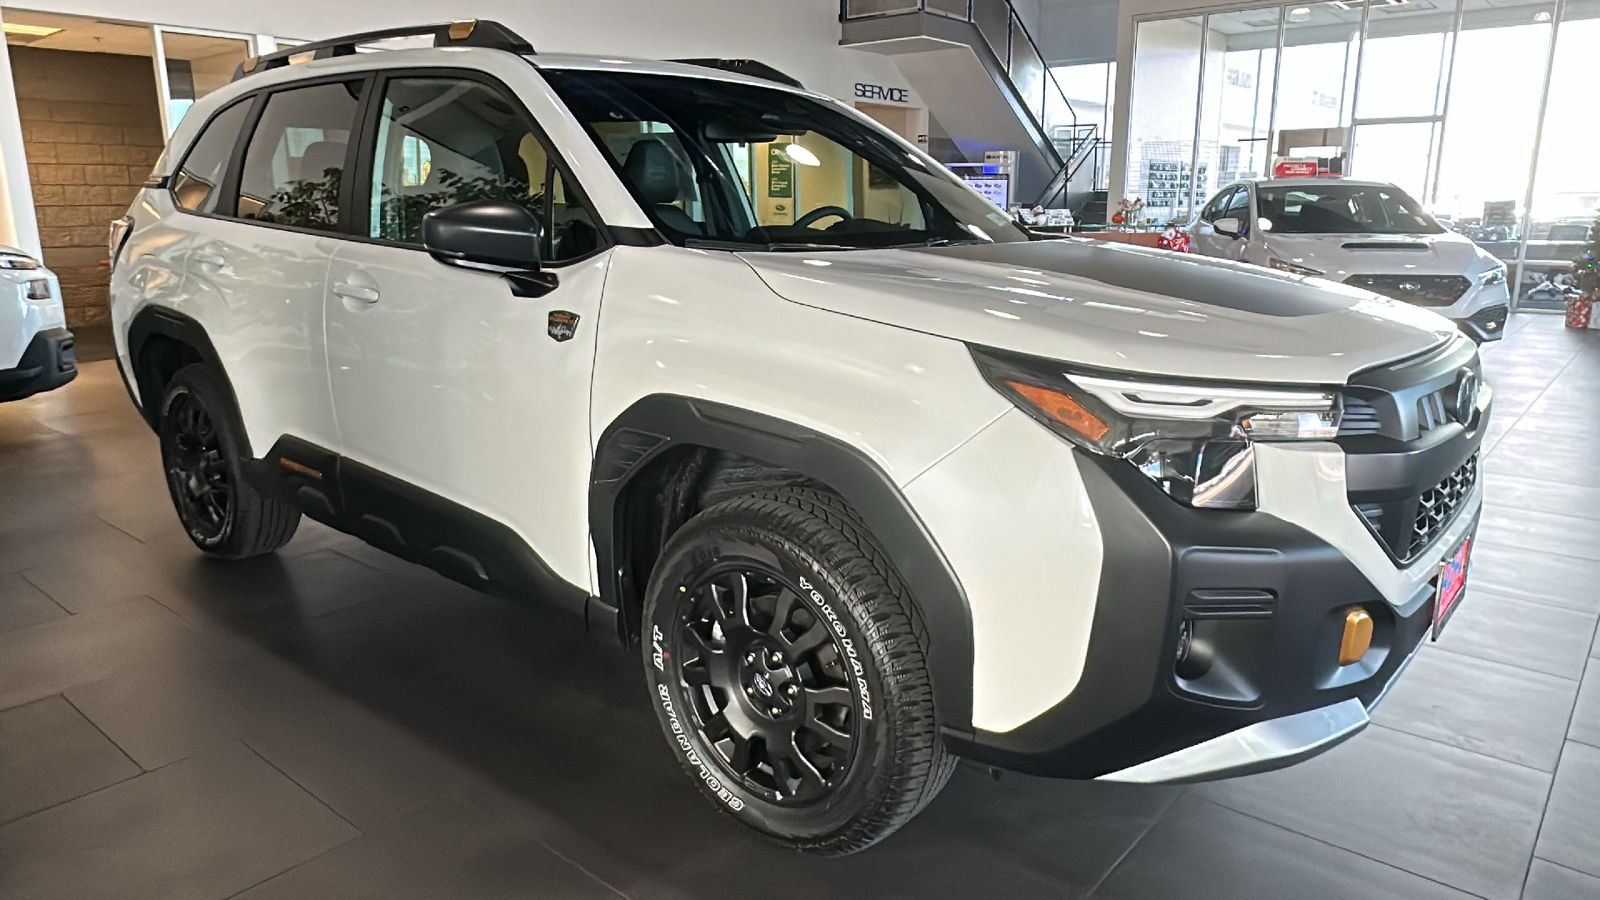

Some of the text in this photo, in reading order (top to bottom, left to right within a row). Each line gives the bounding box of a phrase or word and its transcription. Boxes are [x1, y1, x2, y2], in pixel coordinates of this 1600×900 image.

[854, 82, 909, 103] SERVICE
[652, 624, 745, 812] GEOLANDAR A/T
[799, 576, 873, 720] YOKOHAMA
